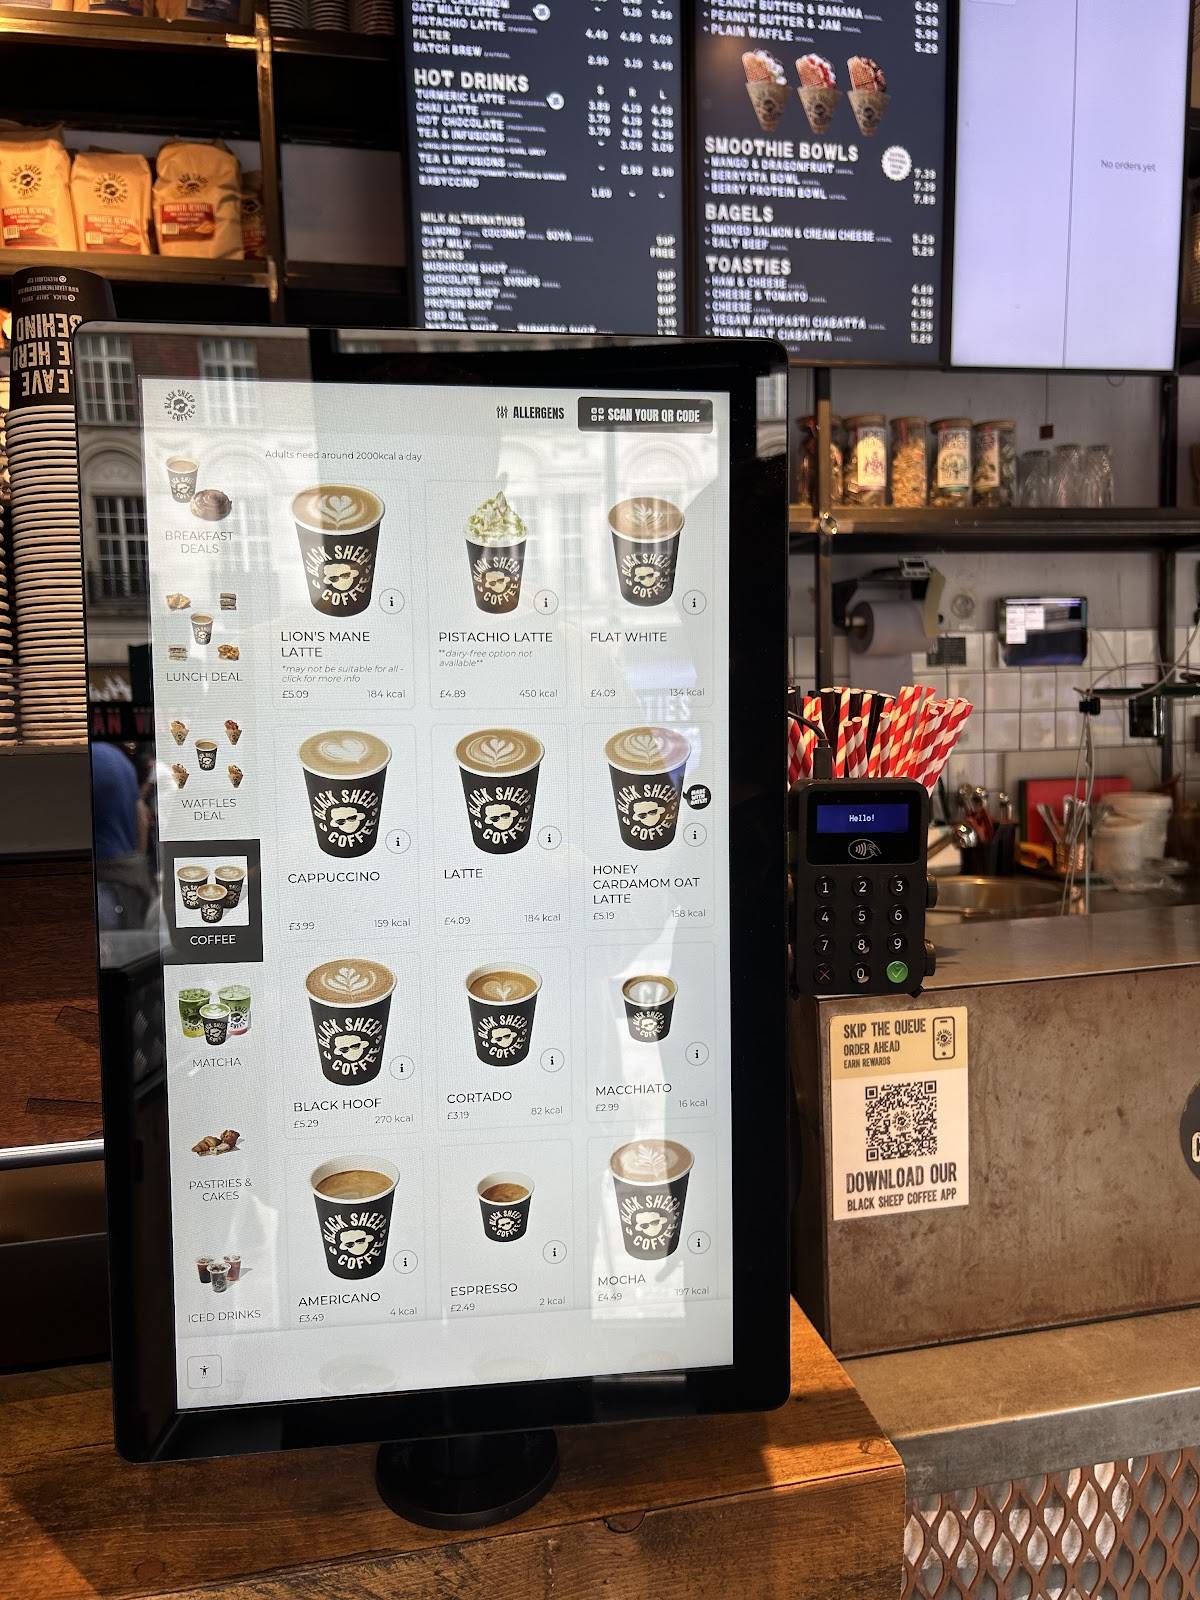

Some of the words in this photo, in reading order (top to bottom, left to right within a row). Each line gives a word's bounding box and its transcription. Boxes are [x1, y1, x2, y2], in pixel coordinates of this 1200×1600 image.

[759, 0, 804, 14] BUTTER
[807, 5, 815, 15] &
[818, 6, 864, 20] BANANA
[710, 10, 756, 24] PEANUT
[759, 13, 804, 28] BUTTER
[807, 18, 816, 30] &
[818, 19, 842, 32] JAM
[710, 24, 745, 37] PLAIN
[748, 26, 794, 42] WAFFLE
[414, 68, 454, 87] HOT
[460, 71, 530, 92] DRINKS
[704, 136, 794, 158] SMOOTHIE
[798, 142, 860, 162] BOWLS
[1100, 159, 1113, 170] No
[1114, 160, 1141, 172] orders
[1142, 162, 1156, 173] yet
[704, 203, 774, 223] BAGELS
[706, 256, 792, 275] TOASTIES
[22, 369, 73, 396] EAVE
[513, 406, 564, 420] ALLERGENS
[608, 408, 632, 421] SCAN
[634, 408, 660, 422] YOUR
[662, 410, 674, 423] QR
[676, 410, 700, 423] CODE
[265, 450, 294, 459] Adults
[296, 451, 320, 459] need
[322, 451, 354, 460] around
[356, 451, 396, 461] 2000kcal
[406, 452, 422, 463] day
[165, 530, 234, 541] BREAKFAST
[181, 544, 220, 554] DEALS
[280, 631, 326, 642] LION'S
[328, 631, 370, 642] MANE
[438, 632, 510, 642] PISTACHIO
[514, 632, 553, 642] LATTE
[590, 632, 620, 642] FLAT
[624, 632, 668, 642] WHITE
[281, 646, 323, 658] LATTE
[488, 650, 517, 659] option
[518, 650, 533, 658] not
[324, 664, 336, 672] be
[166, 672, 208, 682] LUNCH
[210, 672, 242, 682] DEAL
[303, 674, 316, 682] for
[343, 674, 360, 682] info
[282, 690, 309, 699] £5.09
[368, 690, 384, 698] 184
[386, 690, 406, 698] kcal
[440, 689, 466, 698] £4.89
[520, 689, 536, 698] 450
[539, 688, 558, 698] kcal
[590, 689, 616, 698] £4.09
[670, 688, 684, 696] 134
[686, 688, 704, 696] kcal
[181, 798, 237, 809] WAFFLES
[314, 790, 337, 821] BLACK
[341, 788, 377, 810] SHEEP
[194, 812, 225, 821] DEAL
[849, 814, 874, 822] Hello!
[328, 816, 376, 848] COFFEE
[444, 868, 484, 880] LATTE
[592, 864, 638, 876] HONEY
[288, 872, 380, 884] CAPPUCCINO
[592, 878, 671, 890] CARDAMOM
[674, 877, 700, 888] OAT
[823, 882, 829, 894] 1
[859, 882, 867, 892] 2
[896, 881, 903, 892] 3
[592, 894, 631, 904] LATTE
[444, 916, 470, 926] £4.09
[524, 914, 540, 922] 184
[542, 913, 561, 922] kcal
[672, 910, 686, 918] 158
[688, 909, 706, 918] kcal
[822, 912, 830, 922] 4
[858, 910, 866, 921] 5
[894, 910, 902, 920] 6
[288, 922, 315, 930] £3.99
[374, 919, 389, 928] 159
[392, 918, 411, 927] kcal
[190, 934, 236, 945] COFFEE
[822, 940, 829, 950] 7
[858, 940, 866, 950] 8
[894, 938, 902, 950] 9
[856, 968, 864, 979] 0
[844, 1023, 867, 1039] SKIP
[871, 1021, 890, 1037] THE
[894, 1018, 926, 1035] QUEUE
[844, 1042, 870, 1056] ORDER
[873, 1040, 900, 1054] AHEAD
[192, 1057, 242, 1068] MATCHA
[844, 1058, 861, 1069] EARN
[862, 1056, 891, 1068] REWARDS
[595, 1083, 672, 1096] MACCHIATO
[446, 1092, 512, 1104] CORTADO
[294, 1099, 338, 1112] BLACK
[342, 1098, 382, 1110] HOOF
[531, 1107, 542, 1116] 82
[544, 1106, 563, 1115] kcal
[595, 1103, 620, 1112] £2.99
[679, 1100, 688, 1108] 16
[690, 1098, 708, 1108] kcal
[294, 1119, 319, 1128] £5.29
[375, 1115, 393, 1124] 270
[395, 1114, 414, 1123] kcal
[189, 1178, 242, 1190] PASTRIES
[244, 1178, 252, 1187] &
[846, 1165, 924, 1194] DOWNLOAD
[930, 1162, 957, 1184] OUR
[202, 1191, 240, 1202] CAKES
[848, 1196, 875, 1212] BLACK
[878, 1193, 904, 1209] SHEEP
[908, 1190, 938, 1205] COFFEE
[940, 1188, 957, 1201] APP
[598, 1274, 646, 1286] MOCHA
[450, 1283, 518, 1297] ESPRESSO
[598, 1292, 622, 1302] £4.49
[692, 1286, 710, 1296] kcal
[298, 1292, 382, 1307] AMERICANO
[450, 1302, 476, 1312] £2.49
[540, 1298, 545, 1306] 2
[547, 1296, 566, 1306] kcal
[188, 1312, 216, 1323] ICED
[218, 1310, 262, 1322] DRINKS
[298, 1314, 325, 1323] £3.49
[390, 1308, 396, 1316] 4
[398, 1306, 418, 1316] kcal
